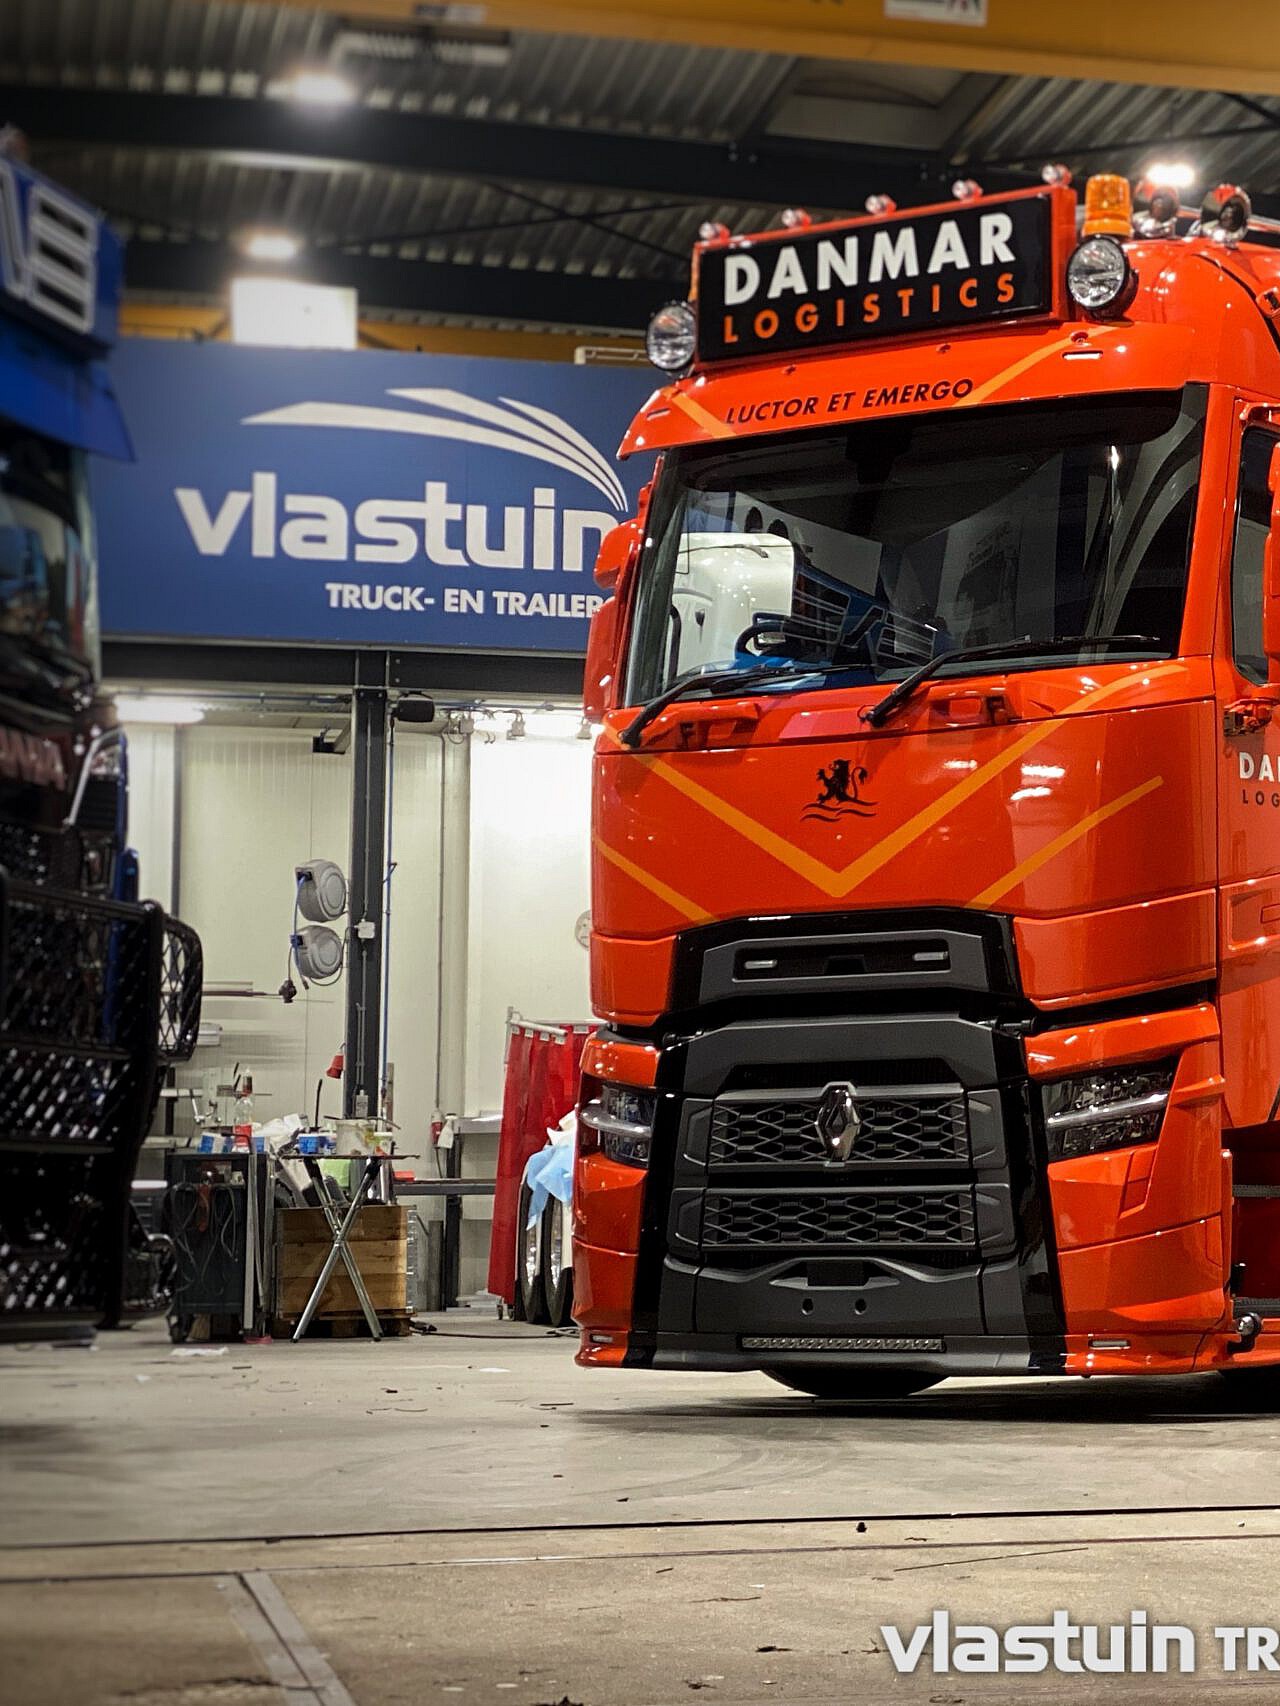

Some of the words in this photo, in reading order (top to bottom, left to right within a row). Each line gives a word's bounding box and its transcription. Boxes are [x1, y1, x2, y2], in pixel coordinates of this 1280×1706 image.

[724, 212, 1016, 306] DANMAR
[723, 272, 1016, 343] LOGISTICS
[726, 398, 816, 424] LUCTOR
[827, 391, 856, 412] ET
[862, 378, 974, 408] EMERGO
[325, 582, 435, 612] TRUCK-
[443, 588, 484, 614] EN
